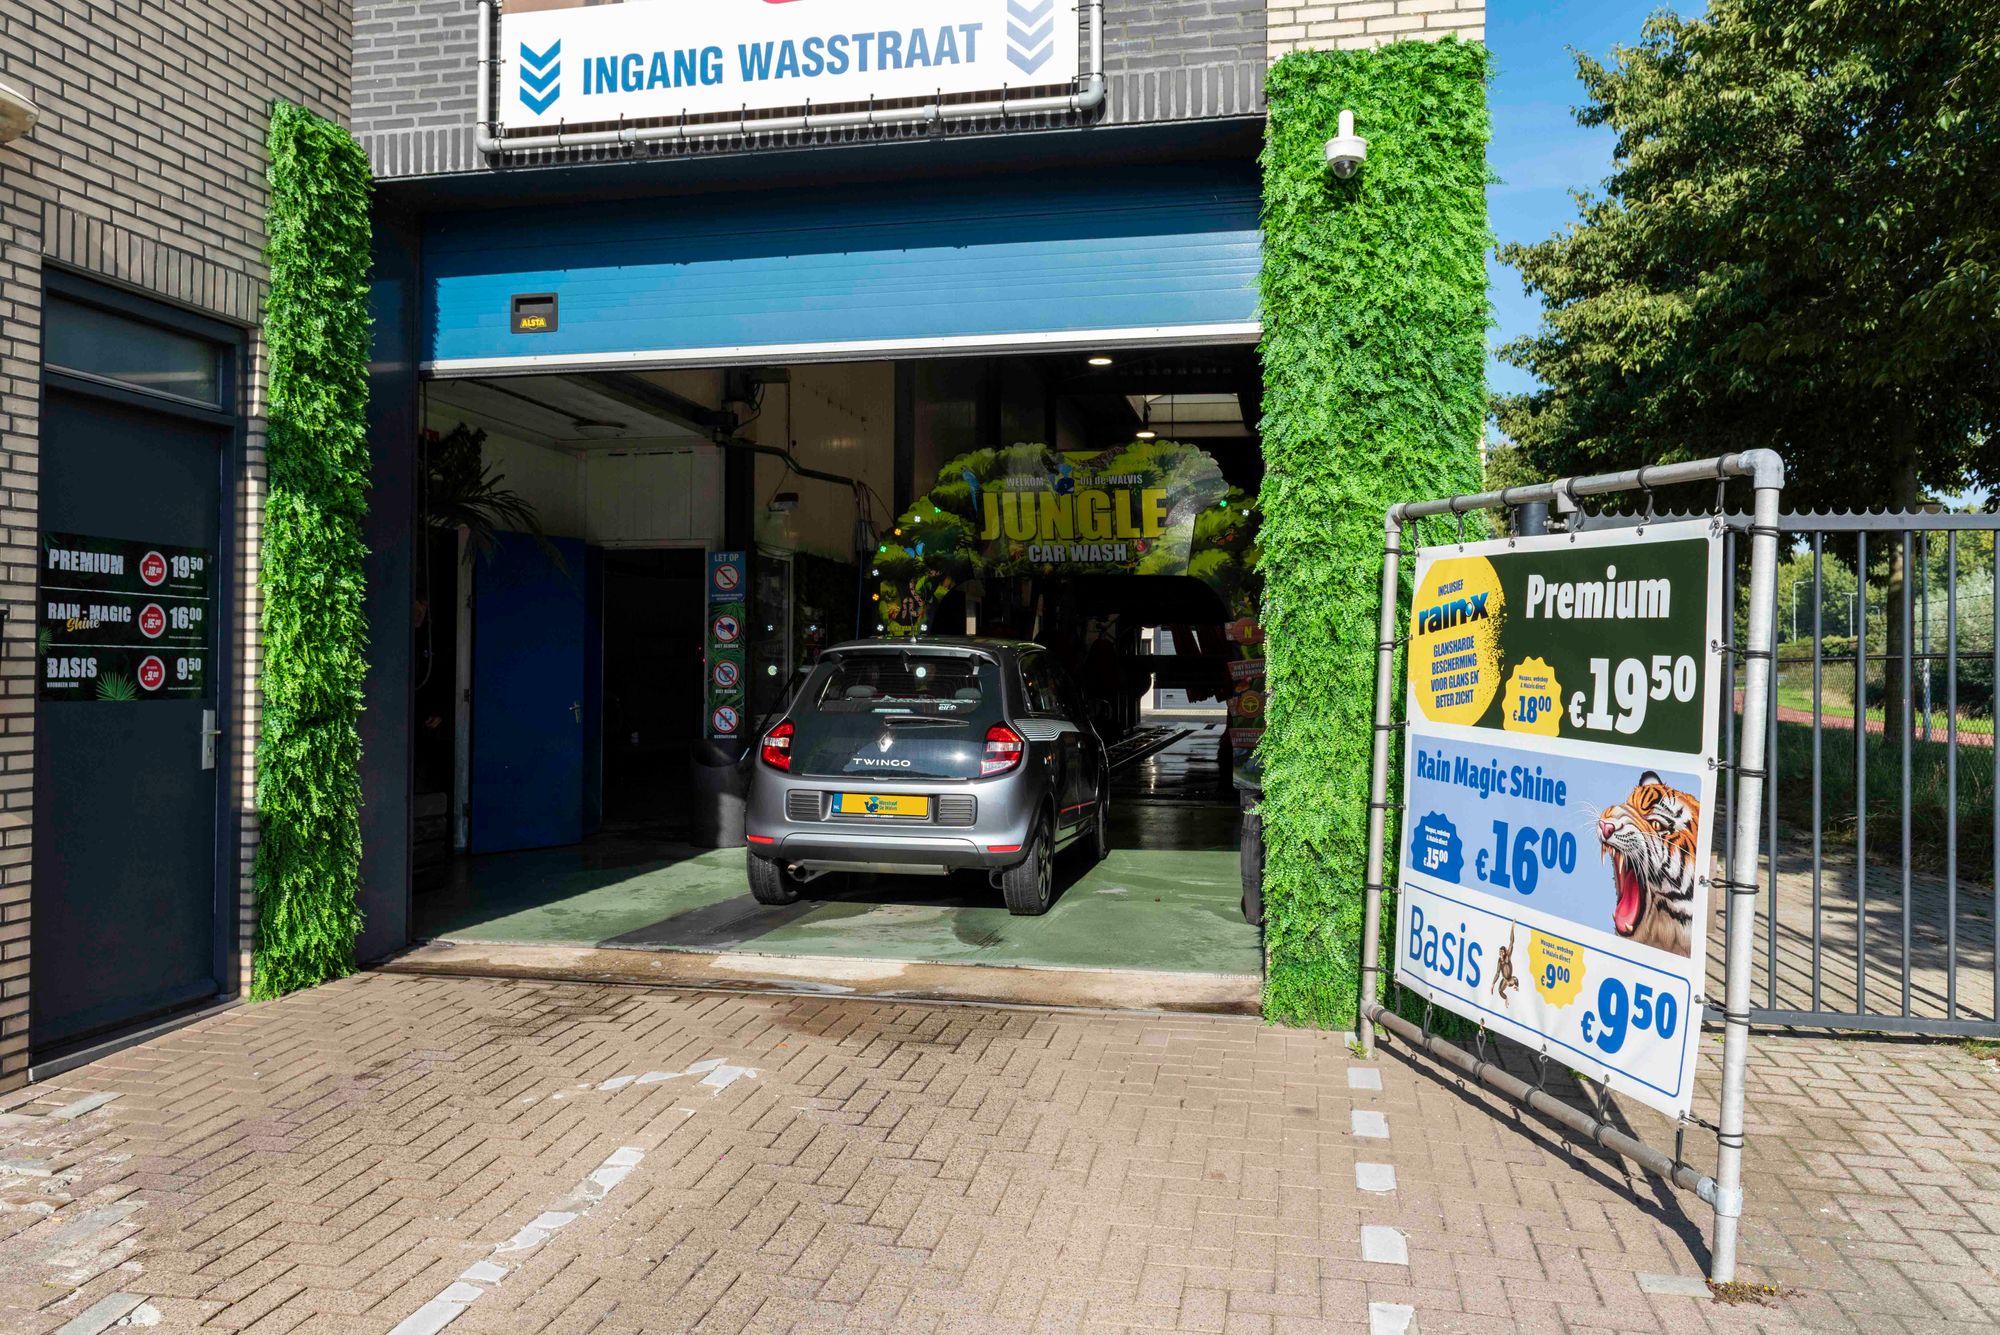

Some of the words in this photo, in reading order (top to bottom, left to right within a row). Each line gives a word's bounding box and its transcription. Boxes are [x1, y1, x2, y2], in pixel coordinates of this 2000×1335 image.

[582, 45, 724, 95] INGANG
[738, 22, 984, 82] WASSTRAAT
[521, 318, 545, 328] ALSTA
[1006, 476, 1044, 488] WELKOM
[1094, 476, 1106, 486] de
[1108, 474, 1143, 485] WALVIS
[980, 488, 1168, 541] JUNGLE
[48, 548, 124, 575] PREMIUM
[714, 553, 728, 562] LET
[729, 552, 739, 562] OP
[1028, 544, 1066, 563] CAR
[1071, 543, 1127, 562] WASH
[1437, 579, 1464, 597] INCLUSIEF
[1525, 564, 1671, 619] Premium
[47, 602, 80, 619] RAIN
[89, 604, 132, 622] MAGIC
[66, 617, 101, 632] Shine
[1433, 635, 1475, 658] GLANSHARDE
[47, 657, 98, 678] BASIS
[1431, 652, 1478, 675] BESCHERMING
[1430, 676, 1448, 692] VOOR
[1448, 671, 1469, 689] GLANS
[1470, 670, 1479, 685] EN
[1435, 691, 1455, 709] BETER
[1455, 689, 1474, 706] ZICHT
[853, 758, 911, 767] TWINGO
[1417, 750, 1450, 783] Rain
[1453, 756, 1507, 800] Magic
[1510, 765, 1567, 807] Shine
[1408, 904, 1483, 988] Basis
